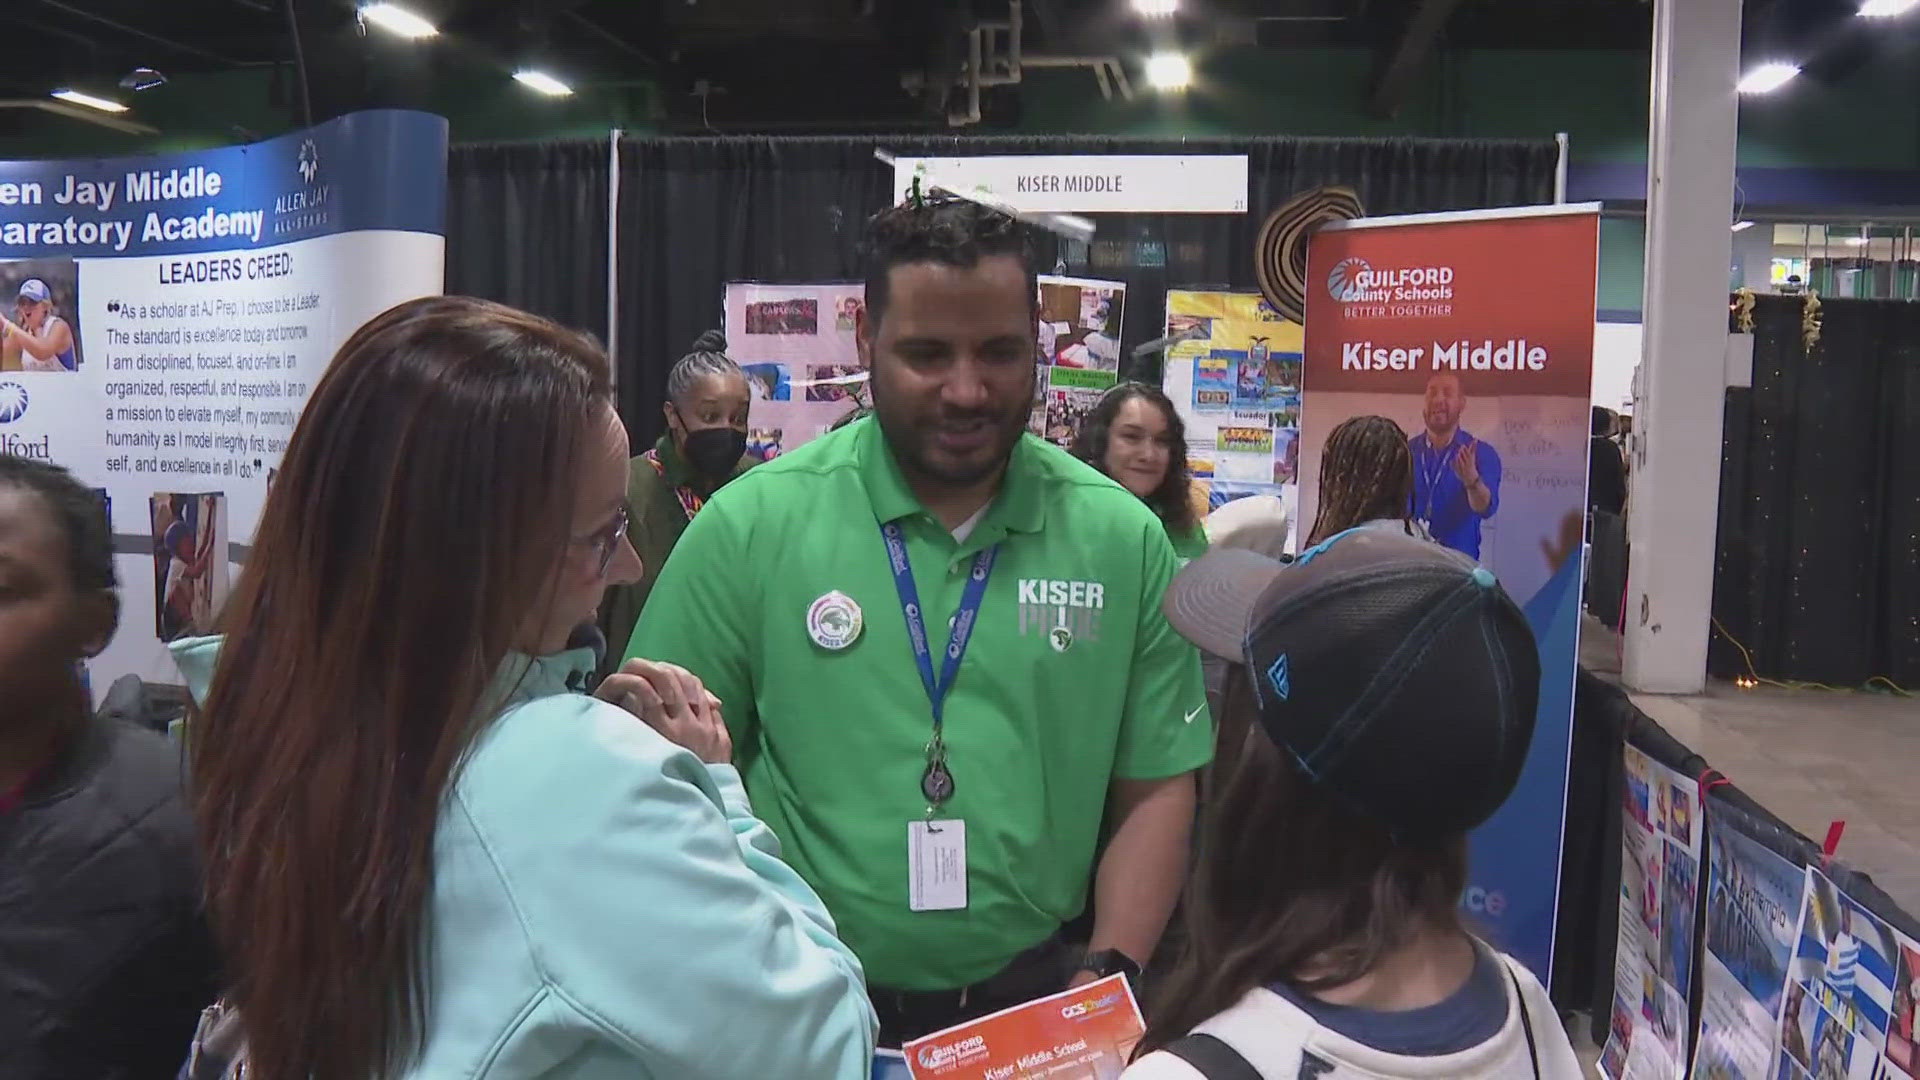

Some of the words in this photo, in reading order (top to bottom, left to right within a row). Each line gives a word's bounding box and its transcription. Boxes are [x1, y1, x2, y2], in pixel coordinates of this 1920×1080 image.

[54, 175, 116, 211] Jay
[126, 167, 222, 203] Middle
[1017, 175, 1060, 192] KISER
[1064, 175, 1122, 192] MIDDLE
[275, 190, 307, 215] ALLEN
[310, 185, 328, 207] JAY
[0, 216, 133, 251] aratory
[141, 207, 264, 243] Academy
[159, 257, 242, 285] LEADERS
[247, 252, 293, 281] CREED:
[1355, 266, 1454, 288] GUILFORD
[1341, 288, 1392, 304] County
[1394, 285, 1453, 301] Schools
[140, 305, 147, 318] a
[150, 301, 188, 319] scholar
[190, 302, 199, 317] at
[201, 300, 213, 317] AJ
[1344, 306, 1385, 318] BETTER
[1390, 304, 1452, 317] TOGETHER
[106, 328, 130, 345] The
[133, 328, 180, 345] standard
[183, 327, 191, 344] is
[194, 326, 241, 343] excellence
[243, 327, 264, 347] today
[266, 323, 279, 342] and
[106, 353, 110, 370] I
[114, 357, 133, 370] am
[236, 352, 252, 370] and
[1341, 341, 1424, 371] Kiser
[1432, 339, 1548, 371] Middle
[105, 379, 167, 400] organized,
[170, 379, 219, 399] respectful,
[221, 379, 237, 396] and
[106, 407, 113, 421] a
[117, 405, 162, 421] mission
[165, 406, 176, 421] to
[178, 405, 212, 422] elevate
[246, 410, 259, 429] my
[106, 429, 161, 451] humanity
[163, 433, 176, 447] as
[185, 431, 212, 448] model
[106, 455, 131, 474] self,
[135, 455, 158, 473] and
[160, 456, 211, 475] excellence
[213, 457, 221, 475] in
[1018, 578, 1105, 609] KISER
[1016, 1050, 1055, 1071] Middle
[1053, 1037, 1088, 1058] School
